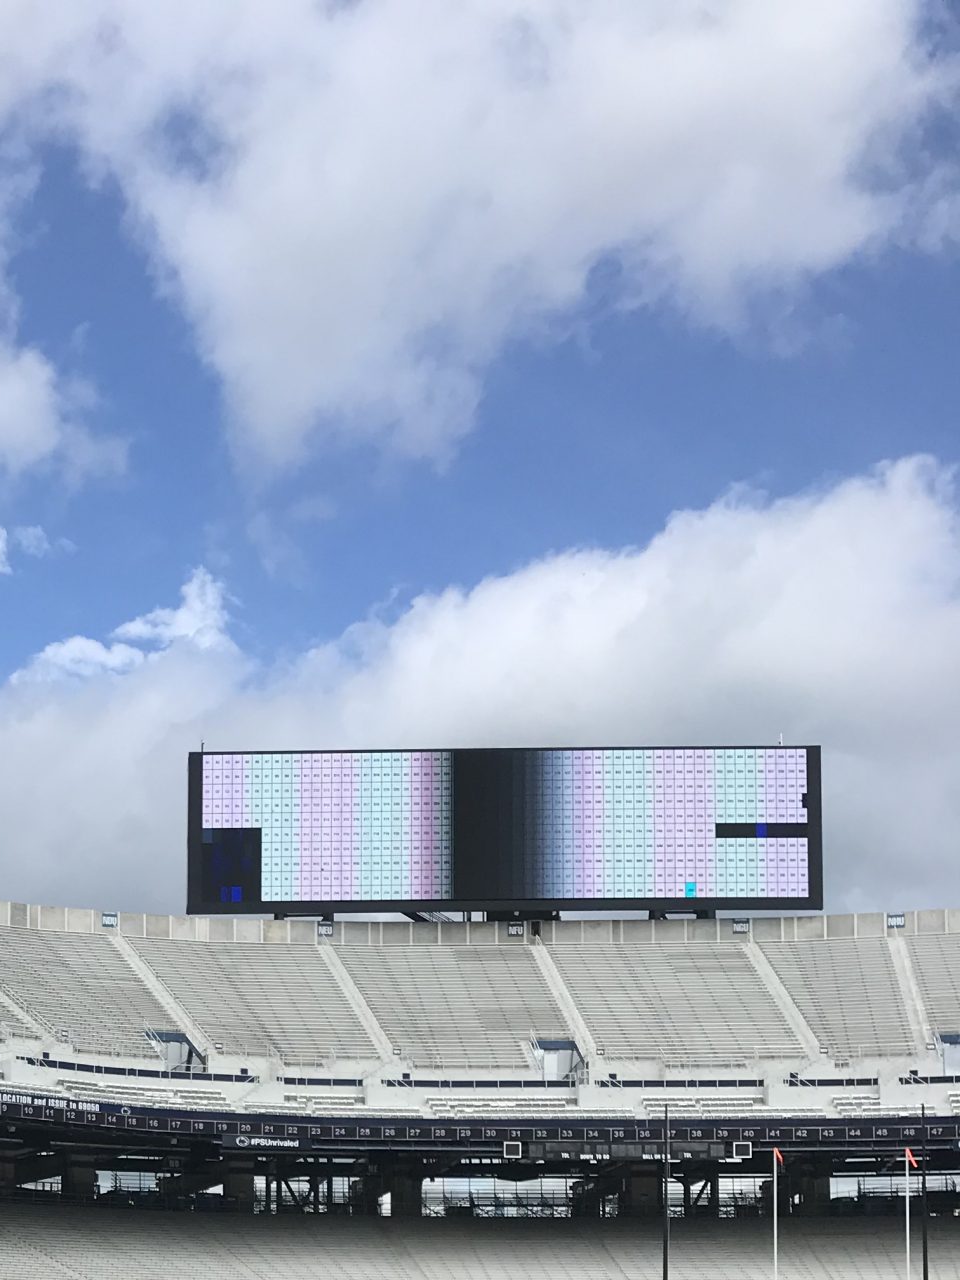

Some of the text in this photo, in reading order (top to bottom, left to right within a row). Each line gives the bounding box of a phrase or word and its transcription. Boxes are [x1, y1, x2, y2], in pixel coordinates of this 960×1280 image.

[0, 1093, 32, 1105] LOCATION
[48, 1098, 68, 1109] ISSUE
[24, 1106, 33, 1114] 10
[66, 1111, 76, 1119] 12
[87, 1113, 96, 1121] 13
[108, 1115, 117, 1123] 14
[128, 1118, 137, 1126] 15
[149, 1119, 158, 1127] 16
[171, 1121, 181, 1129] 17
[194, 1122, 204, 1130] 18
[241, 1124, 251, 1132] 20
[264, 1125, 274, 1133] 21
[288, 1126, 298, 1134] 22
[311, 1127, 321, 1135] 23
[334, 1128, 346, 1136] 24
[360, 1128, 370, 1136] 25
[385, 1128, 396, 1136] 26
[435, 1129, 446, 1137] 28
[536, 1130, 547, 1138] 32
[587, 1130, 599, 1138] 34
[614, 1130, 625, 1138] 35
[639, 1130, 651, 1138] 36
[691, 1130, 702, 1138] 38
[717, 1130, 728, 1138] 39
[743, 1130, 755, 1138] 40
[796, 1129, 807, 1137] 42
[822, 1129, 834, 1137] 43
[876, 1128, 888, 1136] 45
[903, 1128, 915, 1136] 46
[931, 1128, 943, 1136] 47
[251, 1138, 299, 1148] #PSUnrivaled
